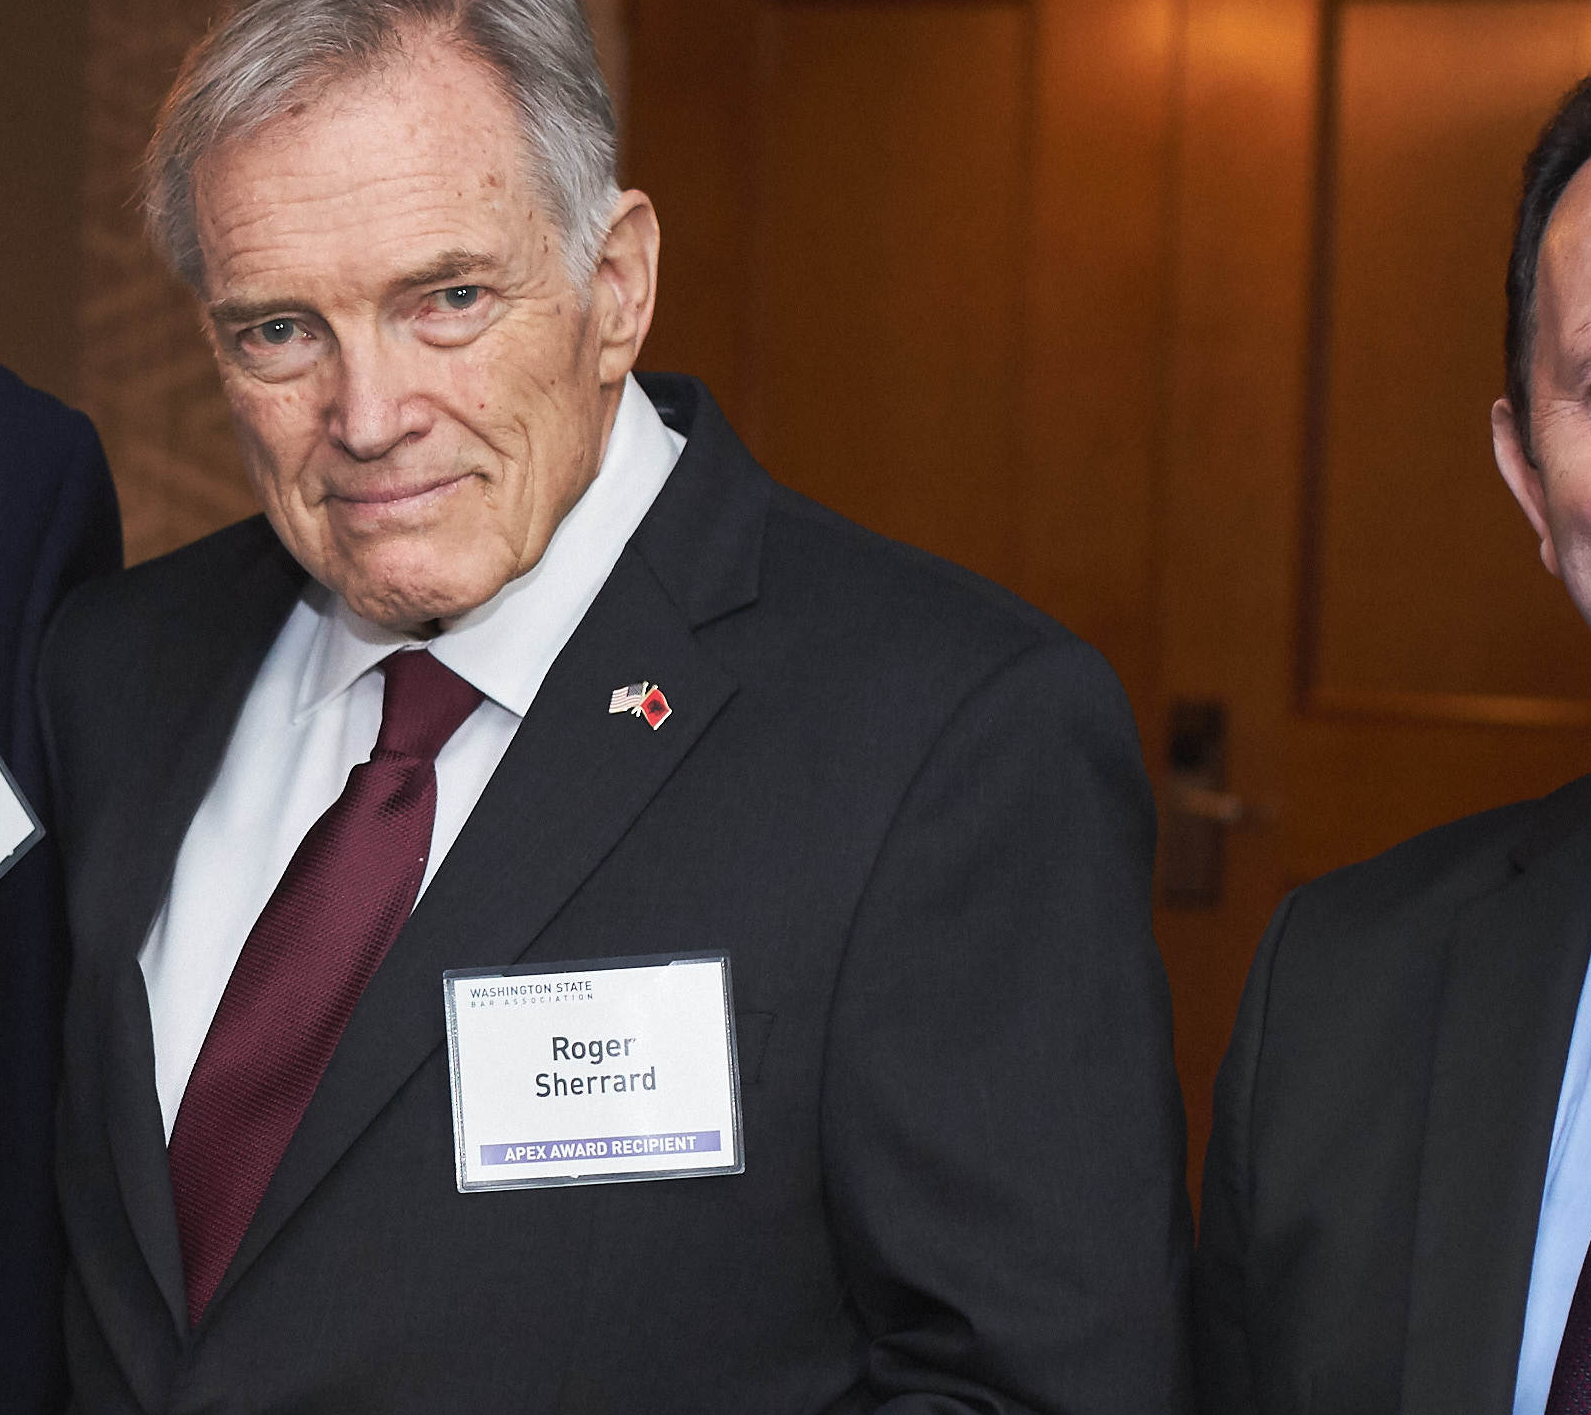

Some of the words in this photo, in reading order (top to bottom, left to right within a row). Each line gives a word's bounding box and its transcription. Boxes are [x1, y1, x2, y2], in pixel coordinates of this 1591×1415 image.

[470, 984, 552, 999] WASHINGTON
[556, 981, 592, 993] STATE
[504, 993, 593, 1006] ASSOCIATION
[551, 1036, 636, 1065] Roger
[535, 1066, 657, 1097] Sherrard
[504, 1145, 547, 1162] APEX
[550, 1141, 608, 1159] AWARD
[611, 1135, 697, 1155] RECIPIENT
